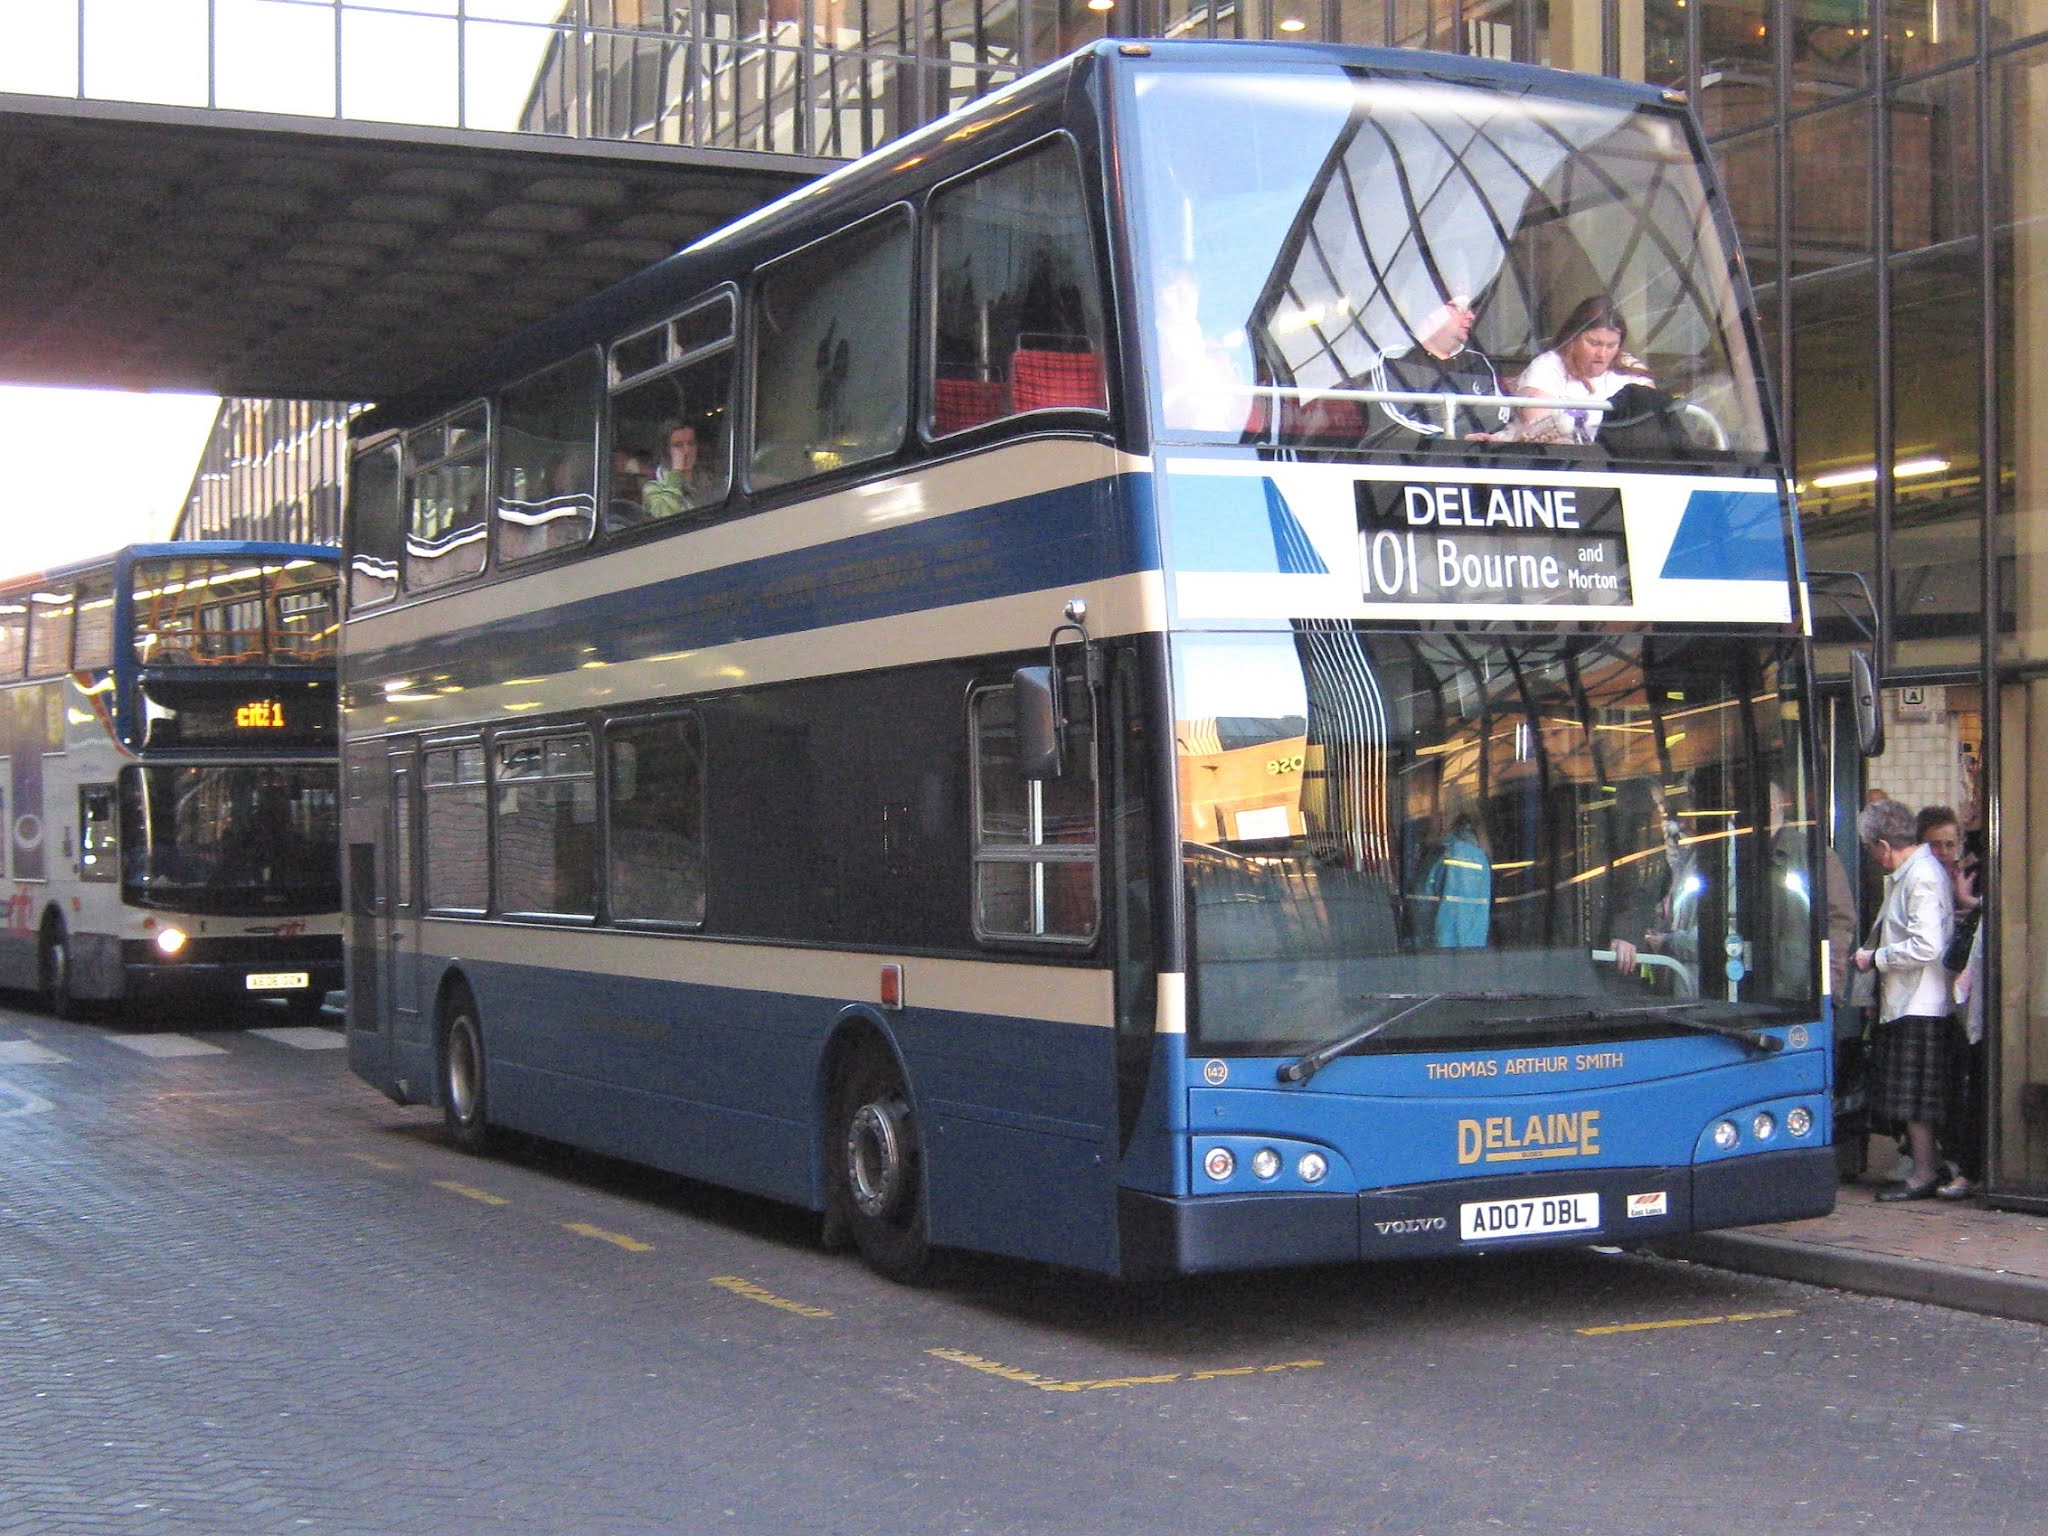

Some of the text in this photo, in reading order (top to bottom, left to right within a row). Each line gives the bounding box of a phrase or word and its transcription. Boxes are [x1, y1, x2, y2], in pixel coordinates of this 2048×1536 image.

[1404, 486, 1580, 529] DELAINE
[1360, 530, 1560, 596] 101 Bourne
[1578, 543, 1604, 563] and
[1568, 569, 1618, 590] Morton
[272, 703, 284, 727] 1
[1208, 1066, 1225, 1078] 142
[1426, 1053, 1624, 1080] THOMAS ARTHUR SMITH
[1457, 1110, 1600, 1165] DELAINE
[1373, 1217, 1447, 1235] VOLVO
[1473, 1199, 1587, 1232] AD07 DBL
